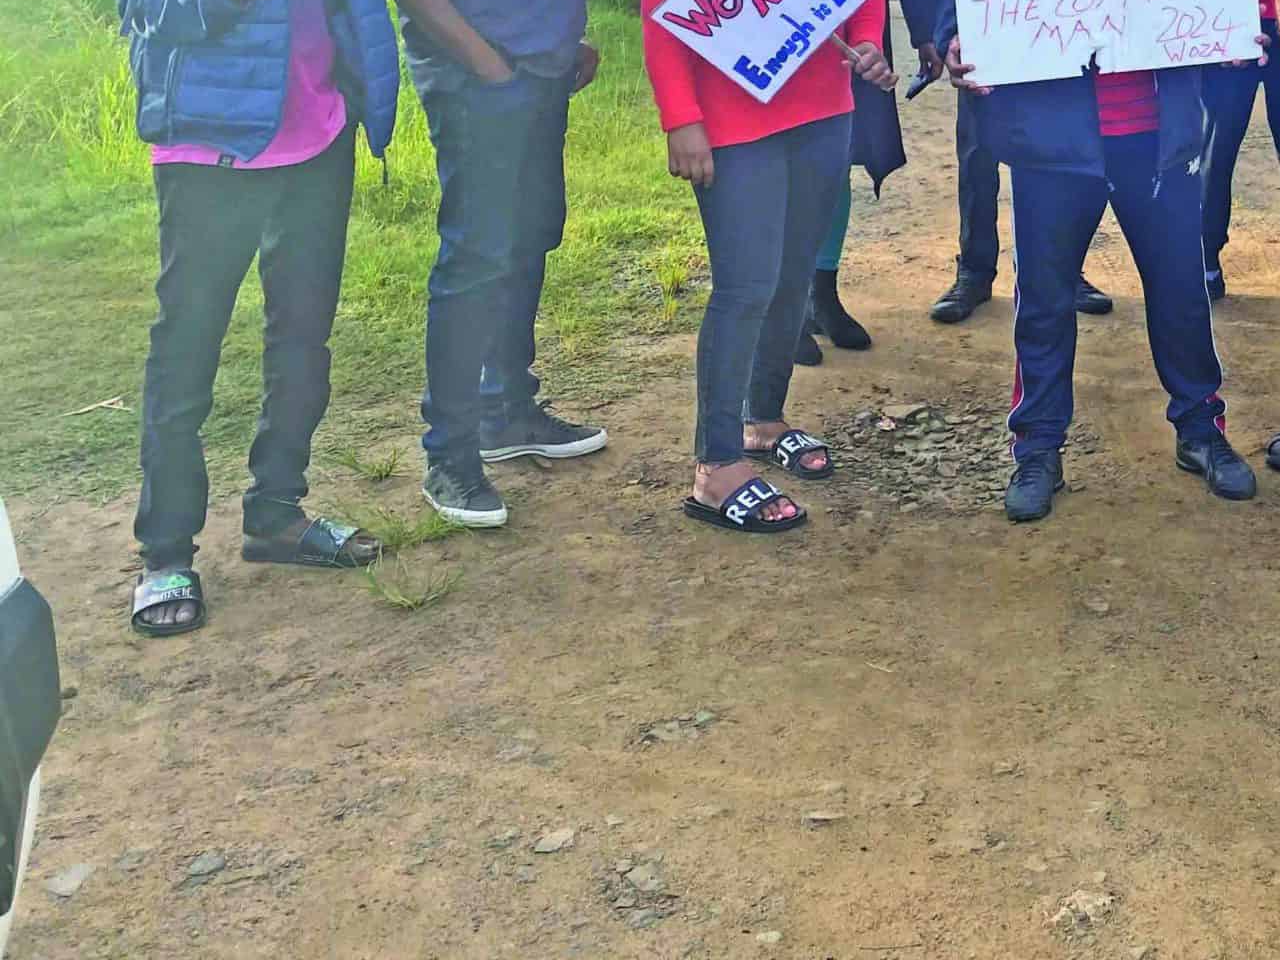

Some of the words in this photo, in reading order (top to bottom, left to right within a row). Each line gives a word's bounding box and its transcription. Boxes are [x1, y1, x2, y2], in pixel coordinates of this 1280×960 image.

[733, 13, 816, 90] Enough
[1031, 14, 1127, 56] MAN
[1156, 7, 1242, 43] 2024
[1163, 40, 1229, 63] WOZA
